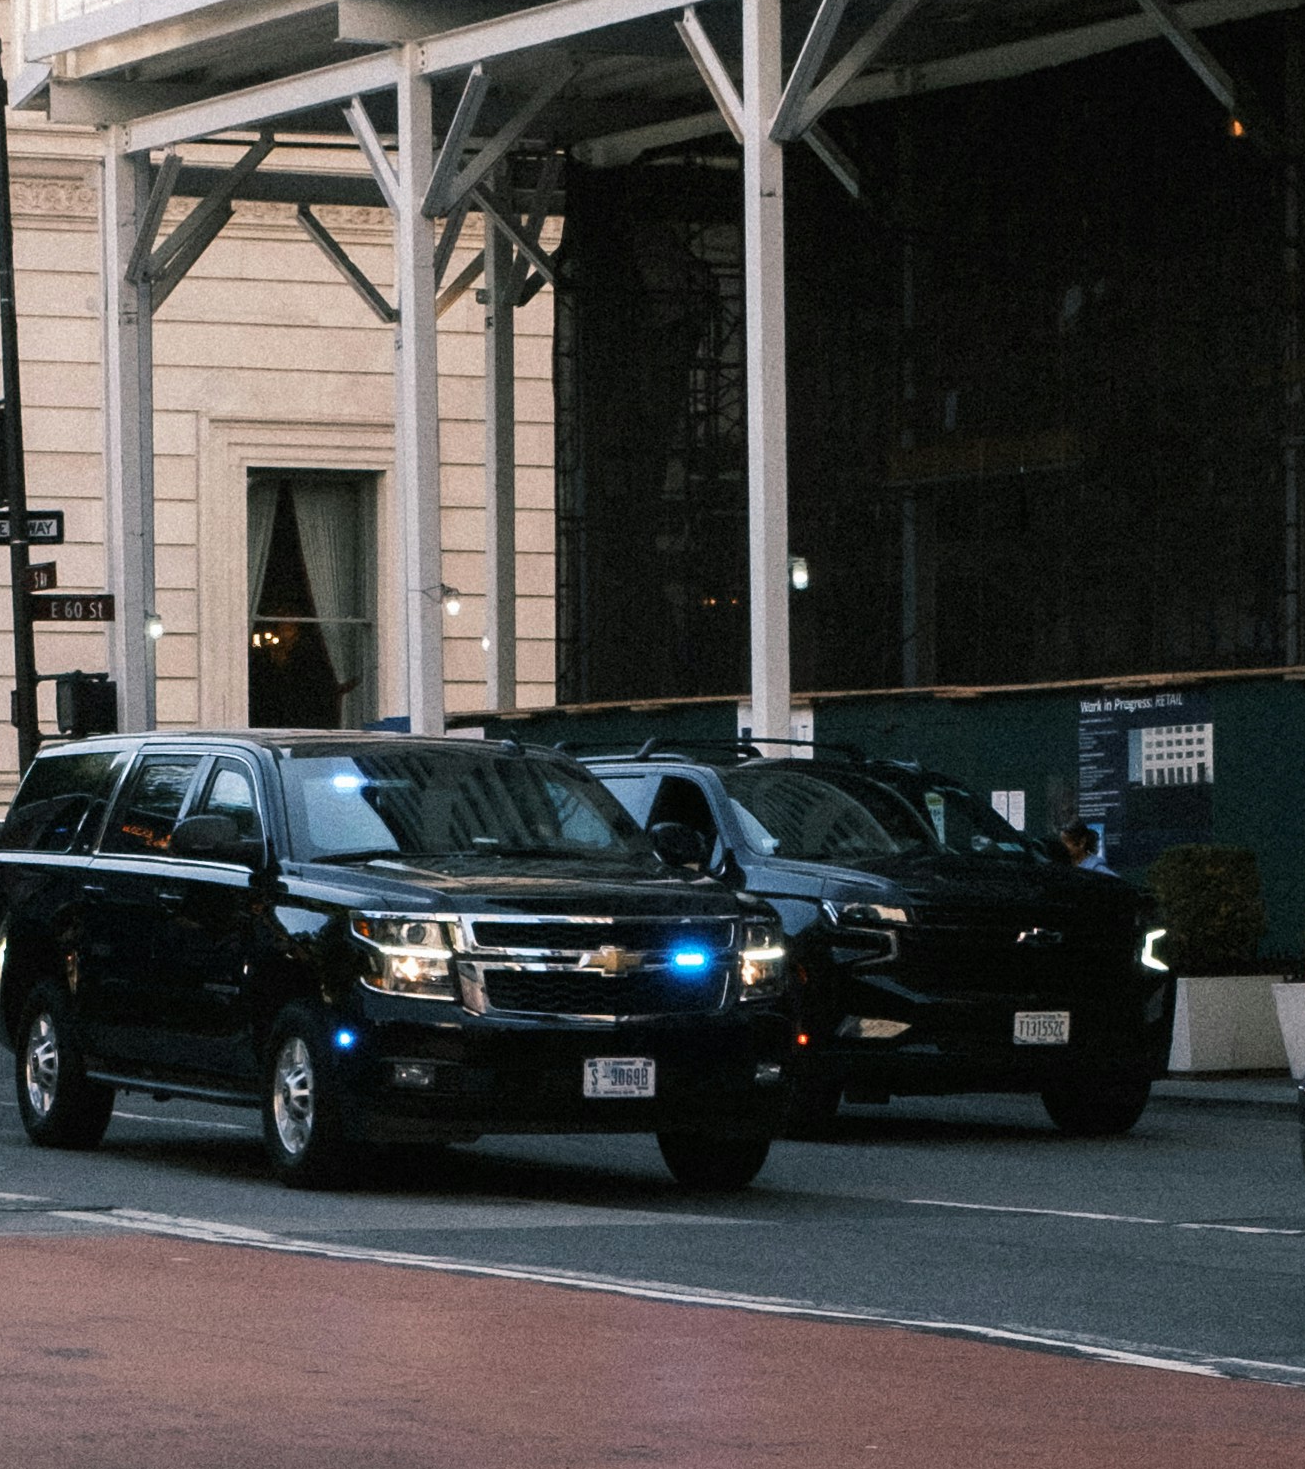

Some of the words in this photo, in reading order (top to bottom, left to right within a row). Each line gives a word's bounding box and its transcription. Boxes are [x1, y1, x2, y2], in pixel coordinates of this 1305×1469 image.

[51, 601, 59, 619] E
[64, 601, 83, 619] 60
[89, 601, 103, 619] St
[1103, 698, 1112, 712] in
[1155, 693, 1183, 708] RETAIL
